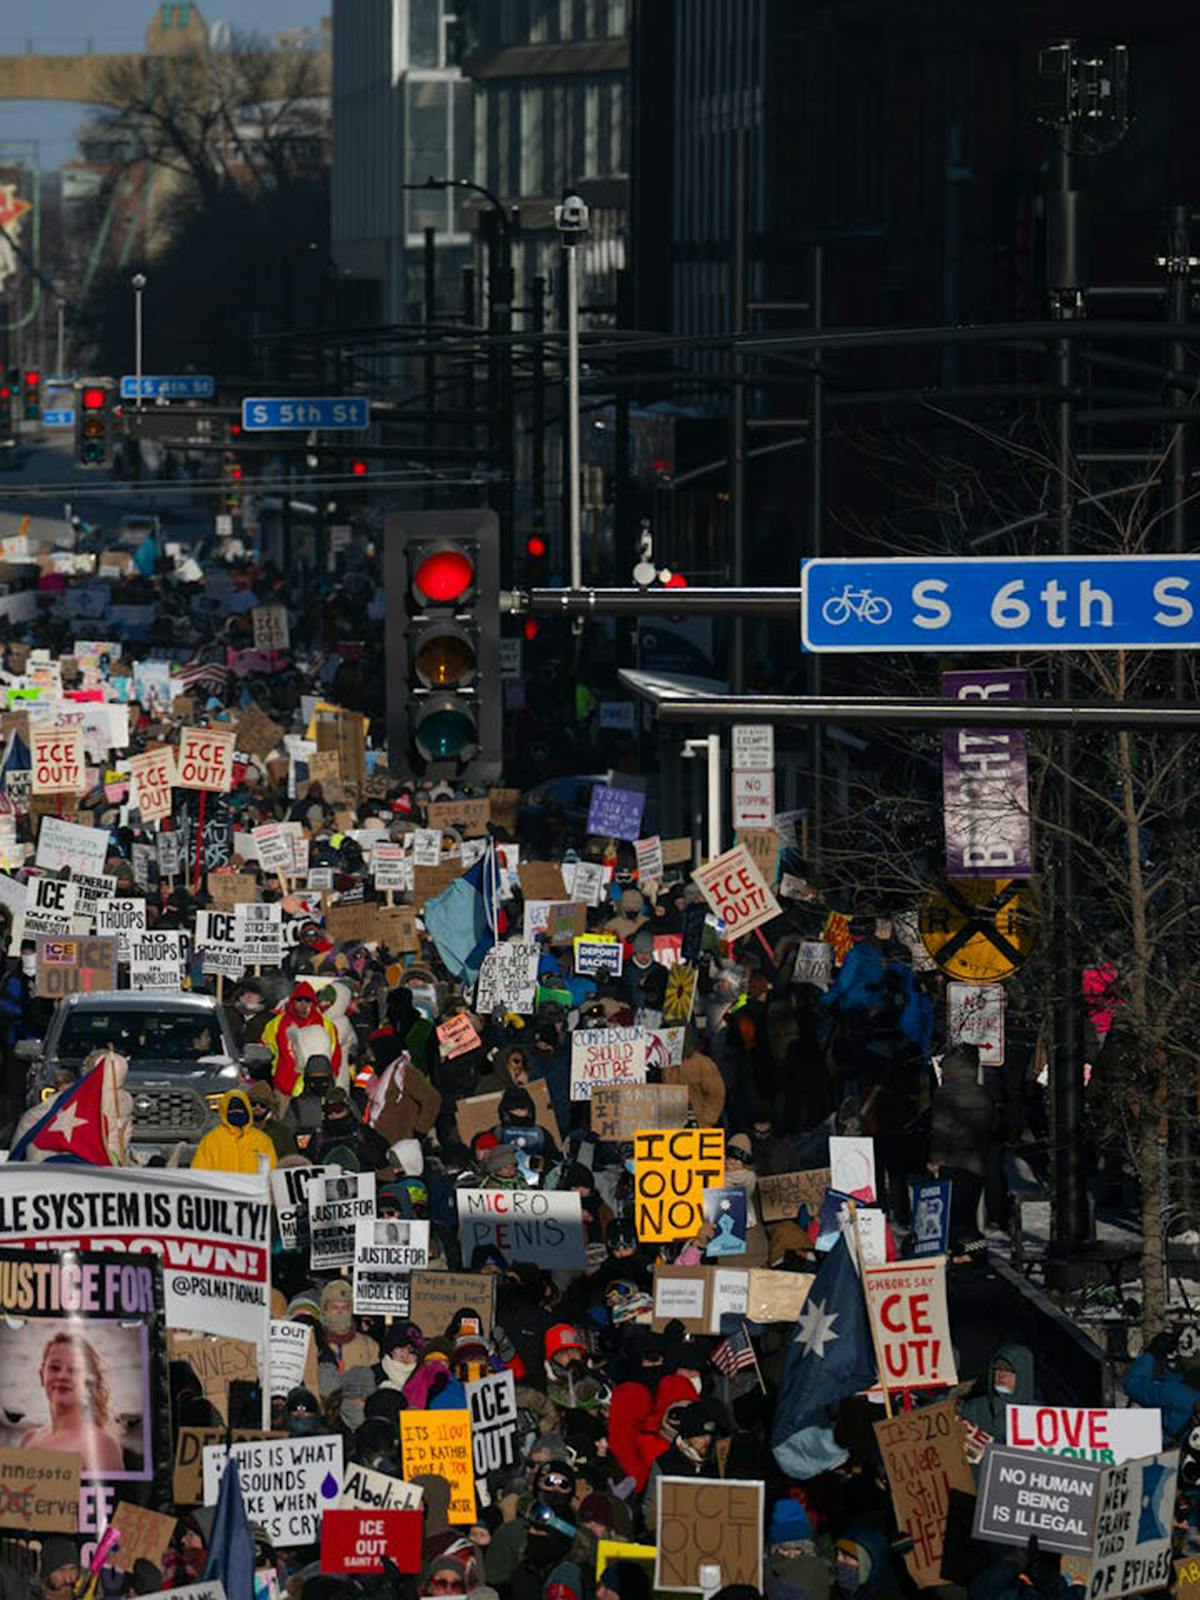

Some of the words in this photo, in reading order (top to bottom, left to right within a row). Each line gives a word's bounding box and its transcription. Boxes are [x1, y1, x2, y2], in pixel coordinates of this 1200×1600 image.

[253, 405, 268, 423] S
[280, 404, 321, 423] 5th
[333, 404, 359, 422] St
[911, 580, 951, 630] S
[990, 578, 1114, 629] 6th
[1153, 576, 1193, 627] S
[36, 744, 75, 763] ICE
[185, 742, 225, 765] ICE
[37, 766, 80, 785] OUT!
[136, 767, 167, 790] ICE
[181, 765, 226, 787] OUT!
[36, 881, 66, 910] ICE
[708, 867, 757, 906] ICE
[25, 911, 48, 920] OUT
[108, 901, 134, 912] NO
[722, 888, 768, 925] OUT!
[100, 911, 145, 931] TROOPS
[207, 912, 235, 942] ICE
[141, 934, 166, 944] NO
[133, 943, 178, 962] TROOPS
[133, 972, 178, 988] MINNESOTA
[636, 1131, 723, 1162] ICE
[638, 1169, 720, 1198] OUT
[311, 1203, 352, 1224] JUSTICE
[352, 1199, 374, 1216] FOR
[467, 1193, 549, 1215] MICRO
[32, 1192, 140, 1231] SYSTEM
[143, 1193, 169, 1227] IS
[176, 1194, 269, 1242] GUILTY!
[638, 1200, 704, 1237] NO
[472, 1217, 566, 1250] PENIS
[357, 1247, 402, 1266] JUSTICE
[403, 1248, 426, 1266] FOR
[105, 1264, 156, 1314] FOR
[172, 1274, 267, 1307] @PSLNATIONAL
[357, 1283, 393, 1301] NICOLE
[913, 1276, 934, 1289] SAY
[880, 1293, 933, 1334] CE
[282, 1326, 306, 1340] OUT
[884, 1340, 941, 1379] UT!
[470, 1381, 509, 1422] ICE
[405, 1426, 429, 1441] ITS
[1011, 1408, 1109, 1449] LOVE
[268, 1447, 286, 1466] IS
[290, 1443, 338, 1467] WHAT
[405, 1446, 426, 1462] I'D
[429, 1444, 469, 1460] RATHER
[473, 1428, 516, 1475] OUT
[999, 1467, 1027, 1485] NO
[1029, 1473, 1094, 1497] HUMAN
[1108, 1466, 1128, 1486] THE
[270, 1490, 319, 1513] WHEN
[662, 1485, 756, 1519] ICE
[1017, 1491, 1071, 1513] BEING
[1105, 1488, 1129, 1514] NEW
[359, 1520, 384, 1535] ICE
[992, 1505, 1011, 1524] IS
[1014, 1508, 1088, 1537] ILLEGAL
[355, 1539, 388, 1556] OUT
[661, 1520, 756, 1555] OUT
[343, 1556, 370, 1567] SAINT
[1091, 1565, 1117, 1599] OF
